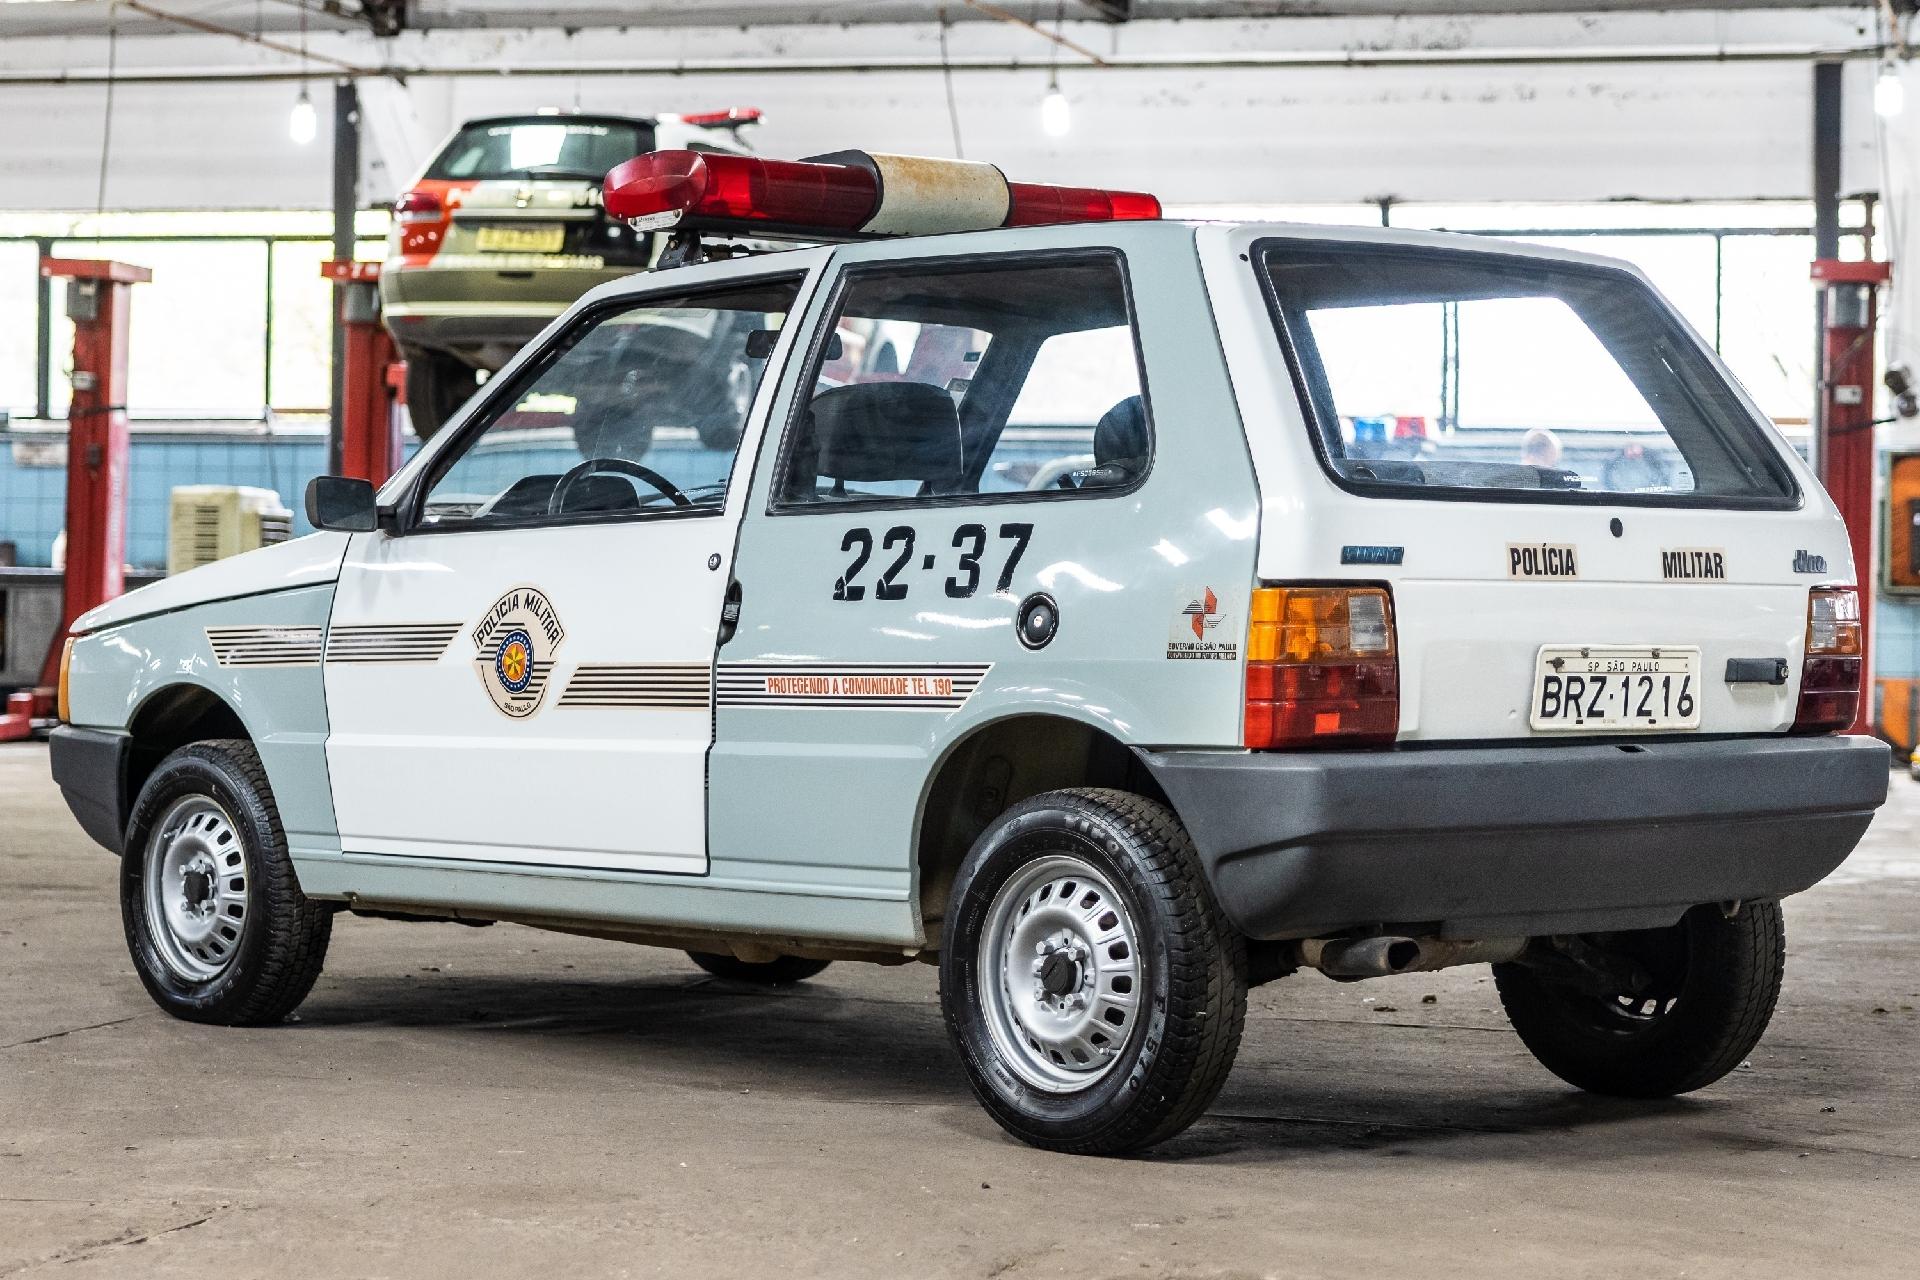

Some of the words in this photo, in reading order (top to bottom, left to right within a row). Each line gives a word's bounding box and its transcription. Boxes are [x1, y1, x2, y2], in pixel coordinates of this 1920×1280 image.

[1510, 543, 1576, 576] POLÍCIA
[1662, 551, 1725, 579] MILITAR
[476, 593, 519, 646] POLÍCIA
[523, 592, 560, 645] MILITAR
[1587, 661, 1600, 672] SP
[1606, 660, 1625, 672] SÃO
[1631, 661, 1660, 672] PAULO
[767, 677, 829, 694] PROTEGENDO
[832, 678, 840, 695] A
[842, 678, 909, 695] COMUNIDADE
